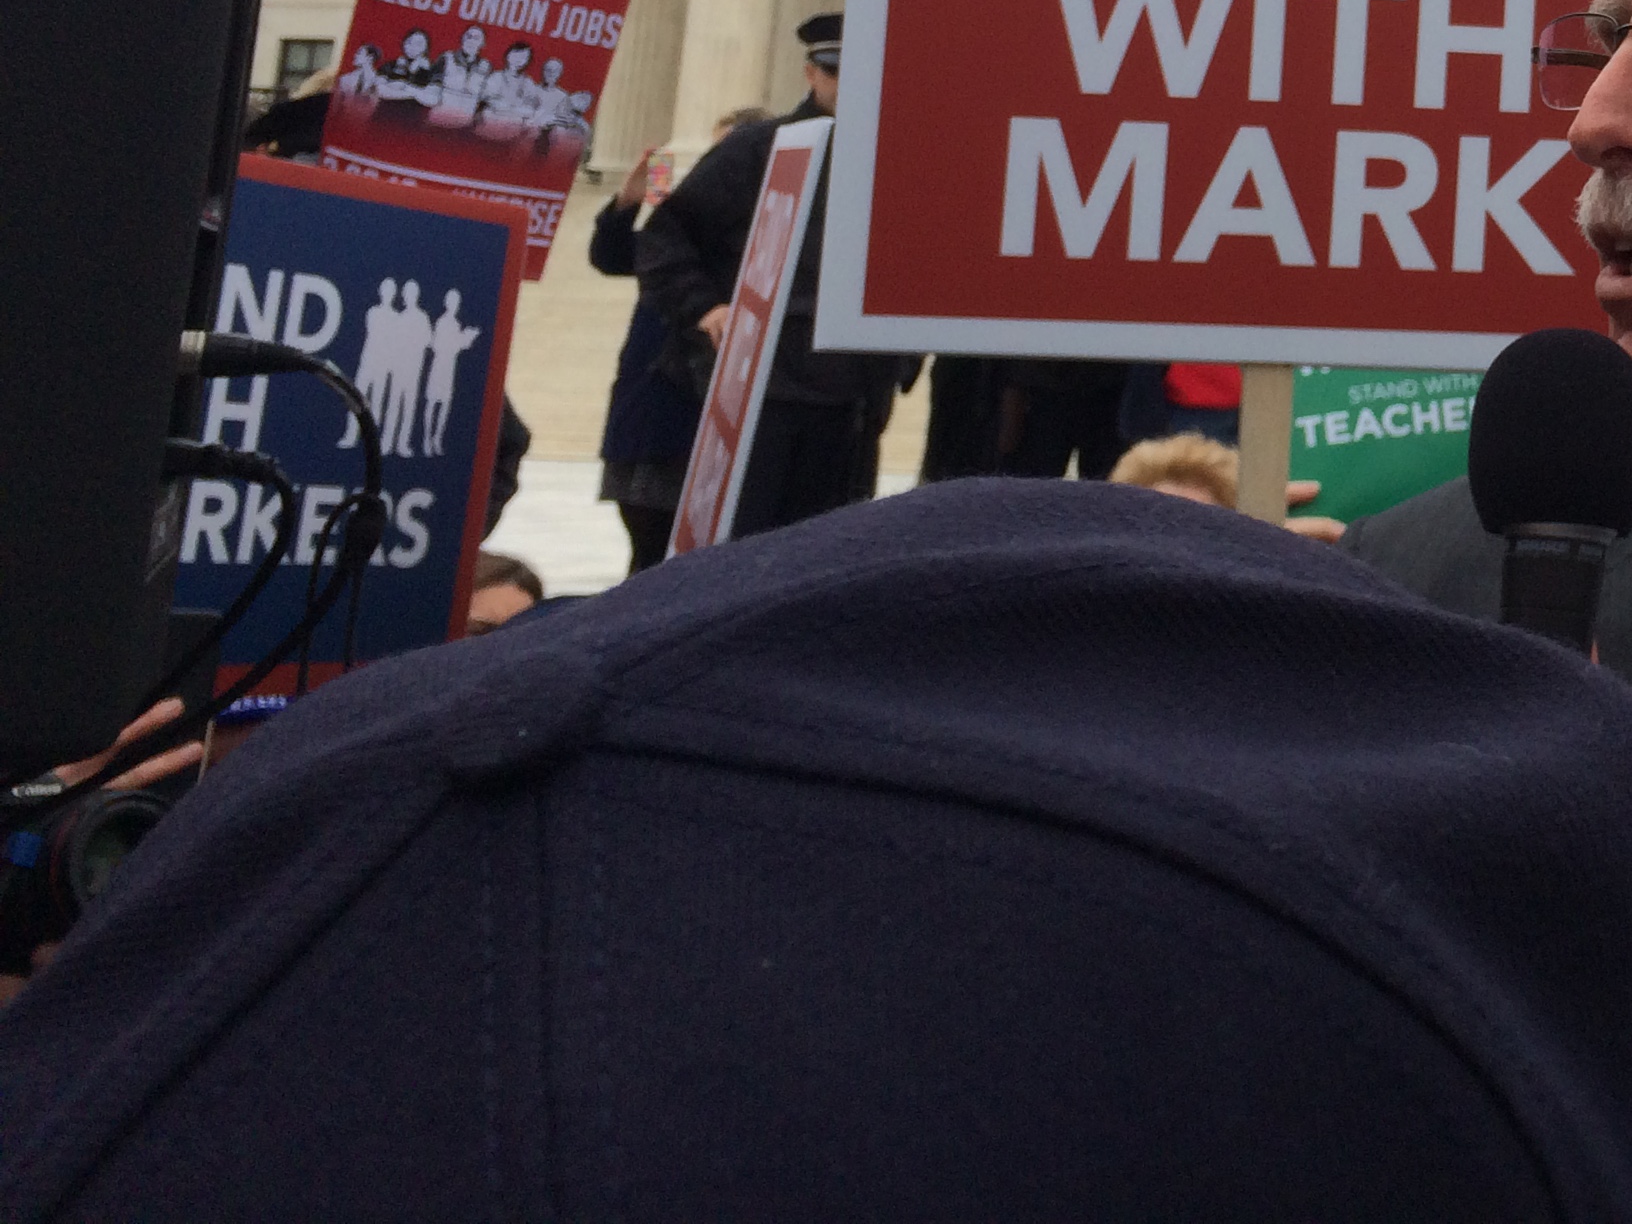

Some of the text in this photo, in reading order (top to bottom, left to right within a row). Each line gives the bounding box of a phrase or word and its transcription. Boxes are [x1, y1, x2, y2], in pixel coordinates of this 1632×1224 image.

[552, 3, 624, 49] JOBS
[1000, 116, 1577, 277] MARK
[1349, 374, 1479, 404] STAND WITH
[1295, 396, 1475, 448] TEACHE
